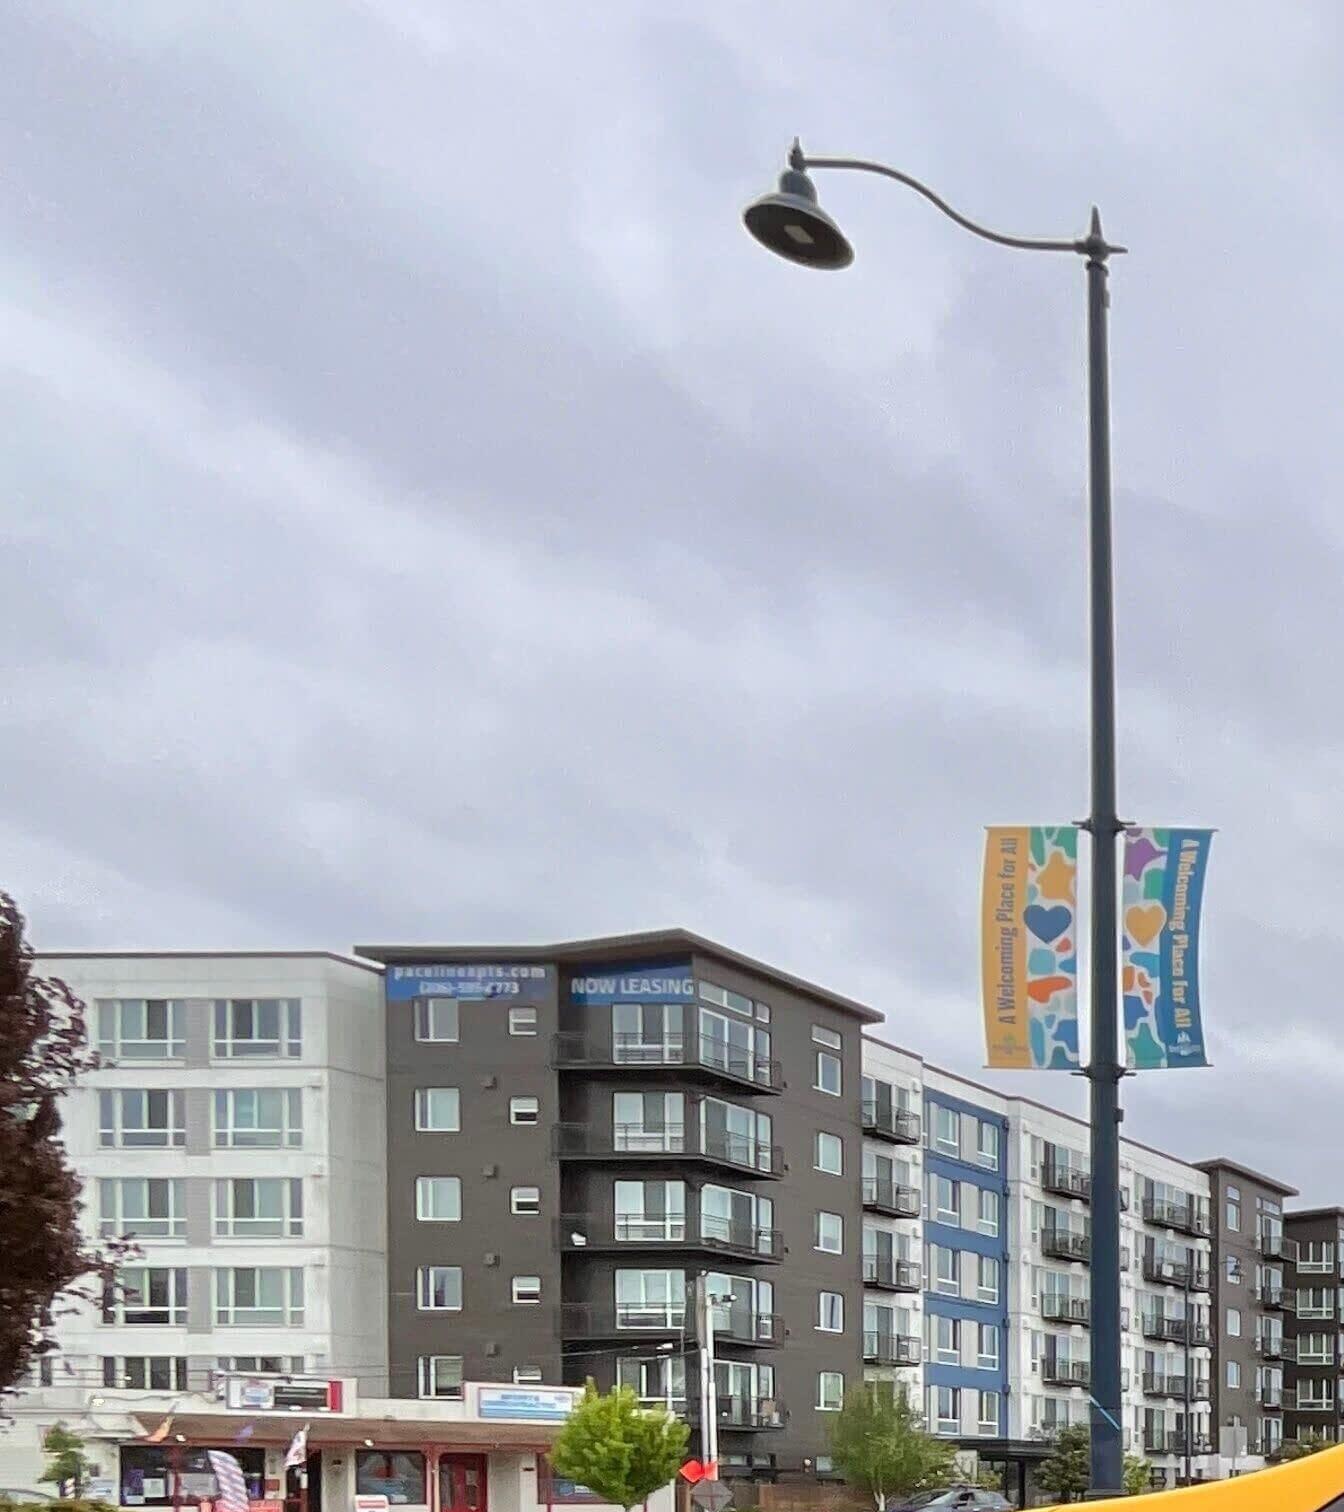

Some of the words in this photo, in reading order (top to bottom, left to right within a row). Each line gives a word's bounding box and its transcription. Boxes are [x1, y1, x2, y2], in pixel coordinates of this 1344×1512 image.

[1000, 838, 1017, 855] All
[1181, 839, 1200, 849] A
[997, 858, 1017, 879] for
[1168, 850, 1197, 931] Welcoming
[995, 882, 1014, 922] Place
[1172, 934, 1189, 976] Place
[995, 926, 1018, 1010] Welcoming
[571, 977, 617, 994] NOW
[620, 978, 695, 995] LEASING
[1172, 980, 1188, 1004] for
[998, 1015, 1016, 1025] A
[1174, 1008, 1192, 1028] All
